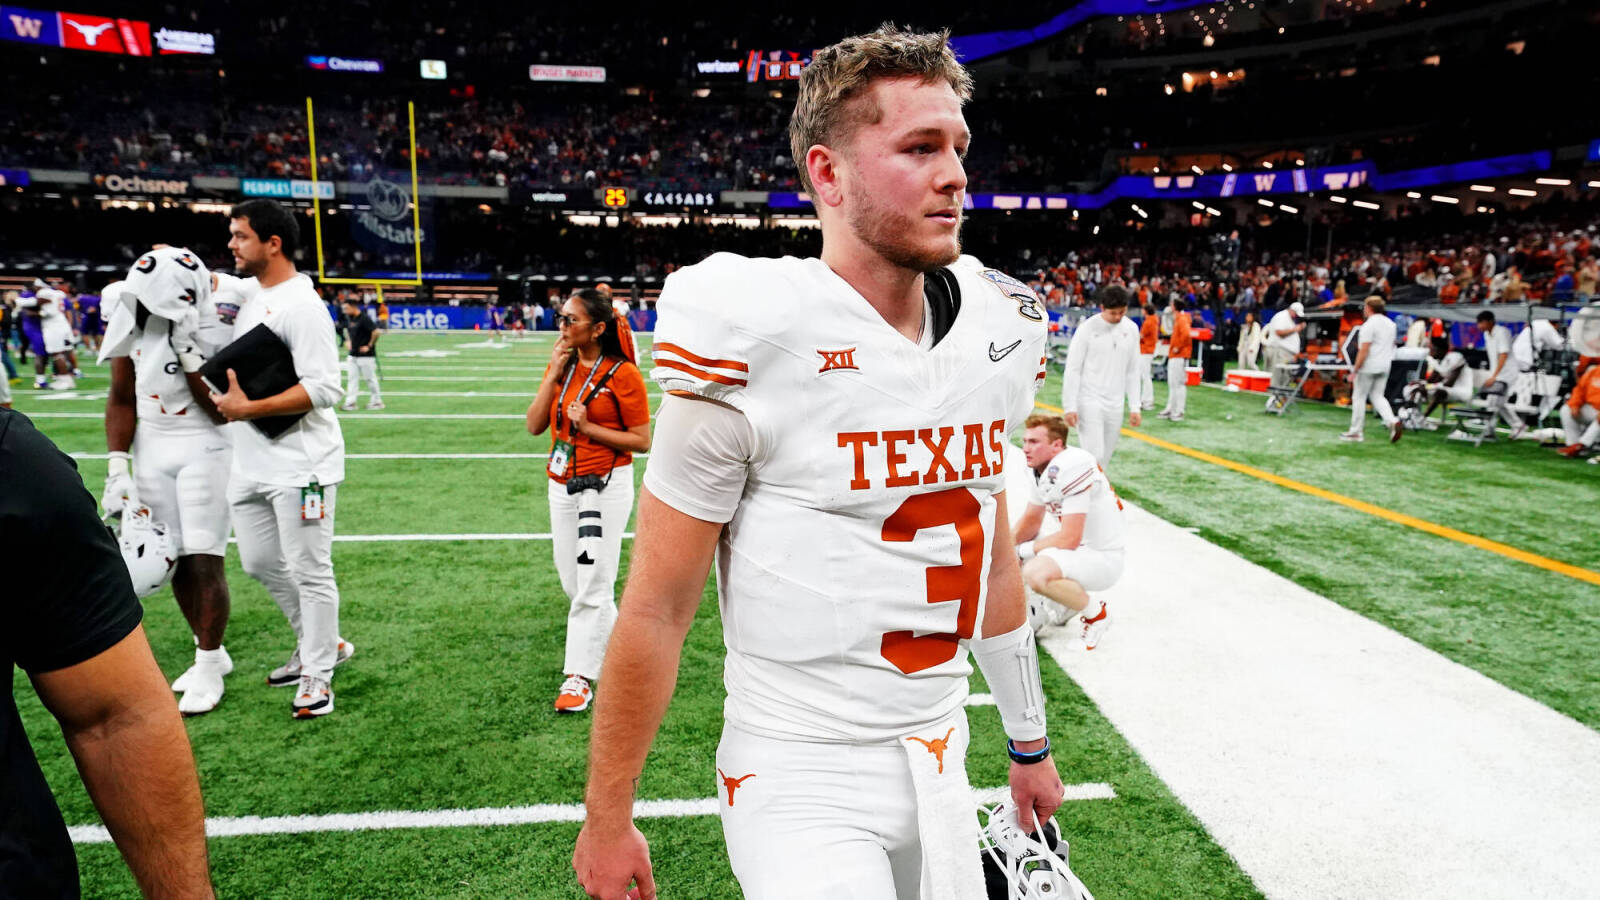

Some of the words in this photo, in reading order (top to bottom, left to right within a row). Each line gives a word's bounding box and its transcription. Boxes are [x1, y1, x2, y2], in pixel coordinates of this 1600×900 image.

[9, 15, 42, 38] W
[697, 60, 740, 73] verizon
[105, 174, 189, 194] Ochsner
[605, 188, 626, 206] 25
[644, 192, 714, 206] CAESARS
[368, 308, 449, 329] state
[837, 419, 1006, 490] TEXAS
[880, 486, 985, 675] 3
